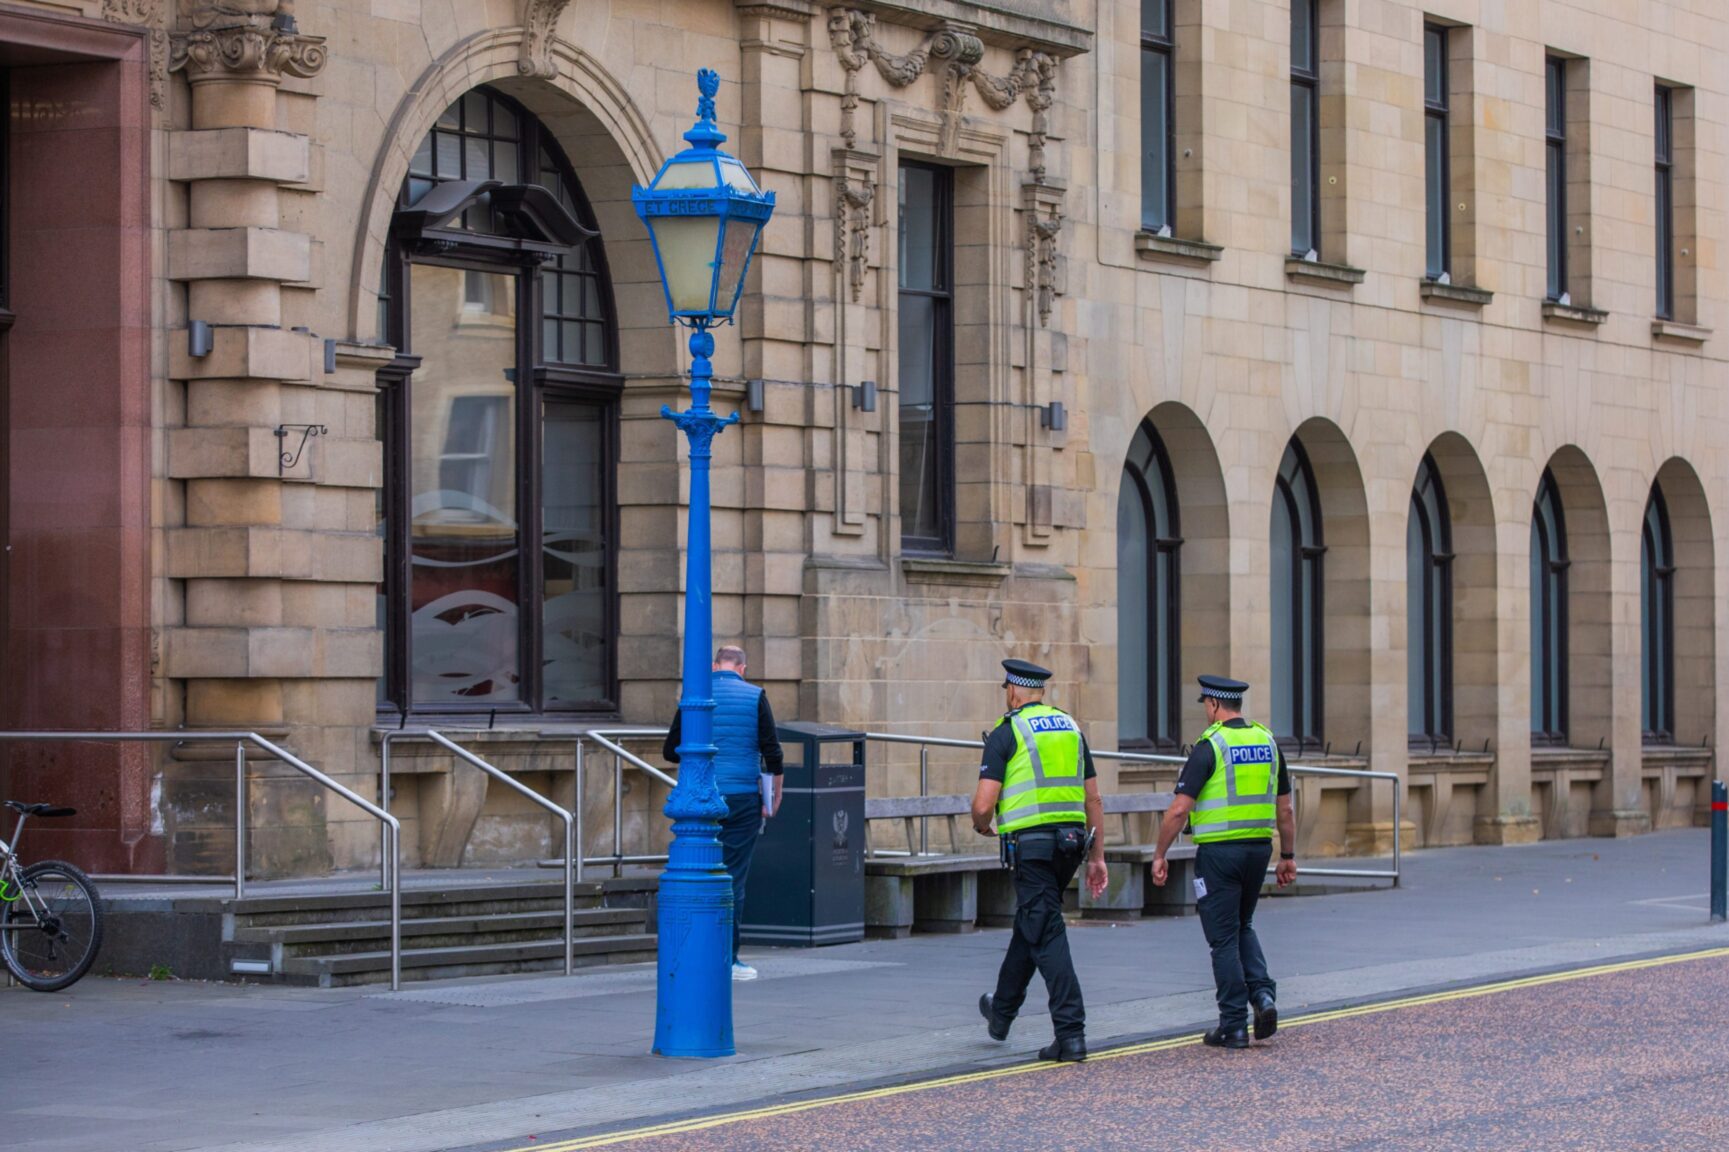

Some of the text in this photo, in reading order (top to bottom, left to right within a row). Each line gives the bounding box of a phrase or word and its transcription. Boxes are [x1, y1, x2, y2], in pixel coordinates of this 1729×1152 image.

[645, 200, 663, 213] ET
[1030, 716, 1073, 731] POLICE
[1231, 747, 1271, 762] POLICE
